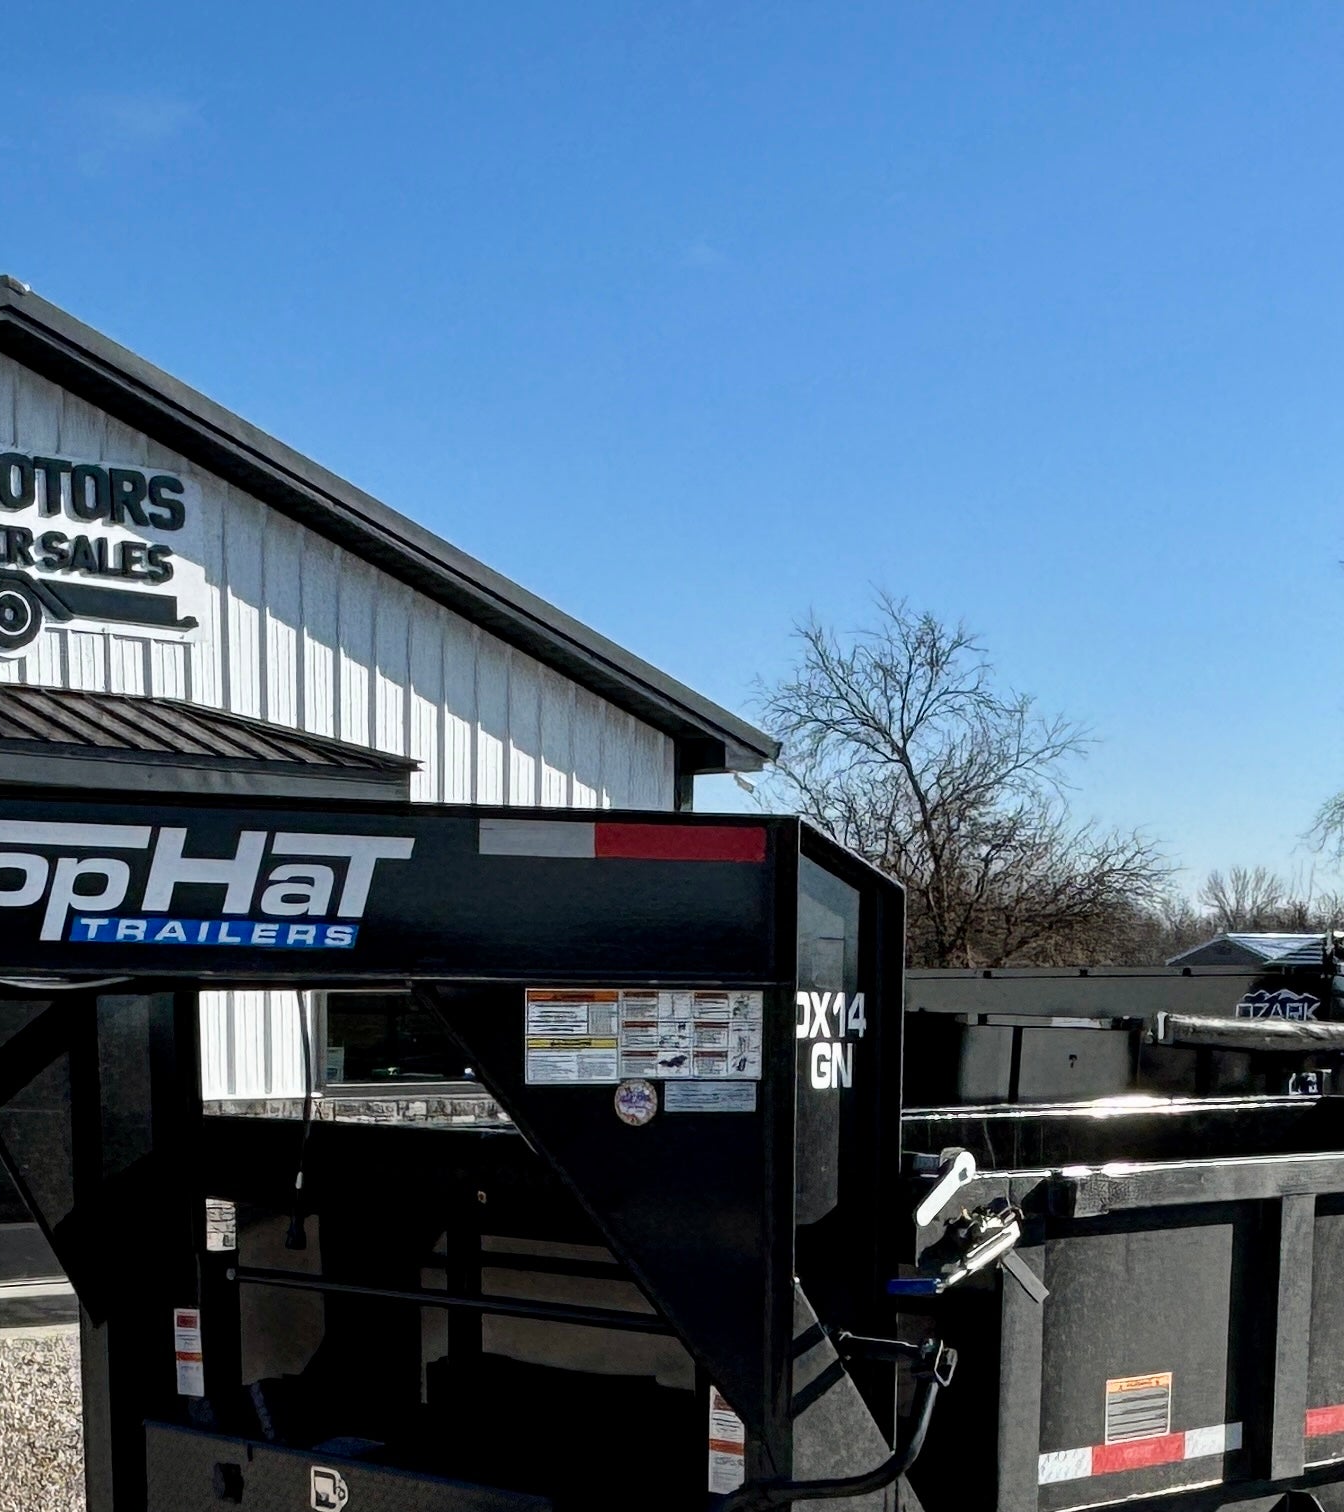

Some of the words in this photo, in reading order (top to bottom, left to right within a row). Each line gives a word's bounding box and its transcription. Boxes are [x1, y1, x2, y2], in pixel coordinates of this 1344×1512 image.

[35, 529, 174, 583] SALES
[79, 917, 355, 947] TRAILERS
[811, 1042, 853, 1089] GN
